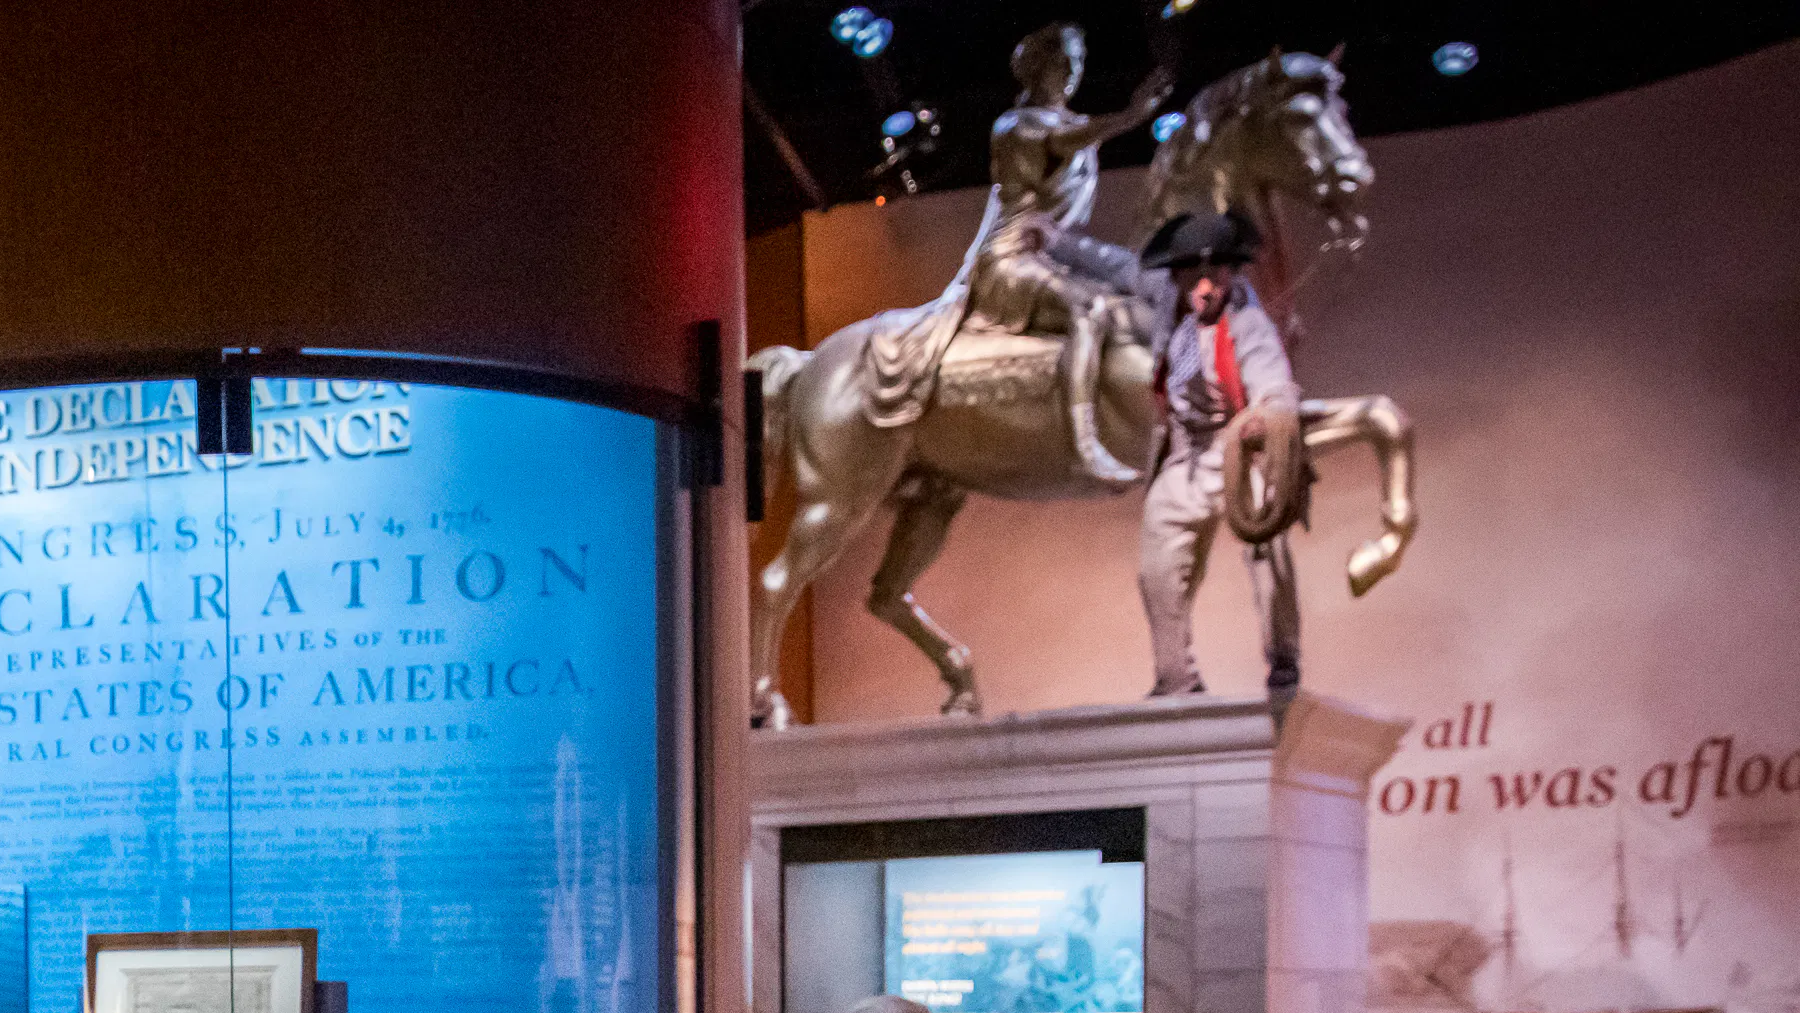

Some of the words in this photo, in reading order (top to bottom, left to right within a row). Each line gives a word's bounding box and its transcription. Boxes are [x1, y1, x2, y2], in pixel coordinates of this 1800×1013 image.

[268, 505, 365, 543] JULY
[216, 673, 285, 712] OF
[89, 725, 281, 755] CONGRESS
[1421, 701, 1494, 749] all
[1488, 765, 1617, 811] was
